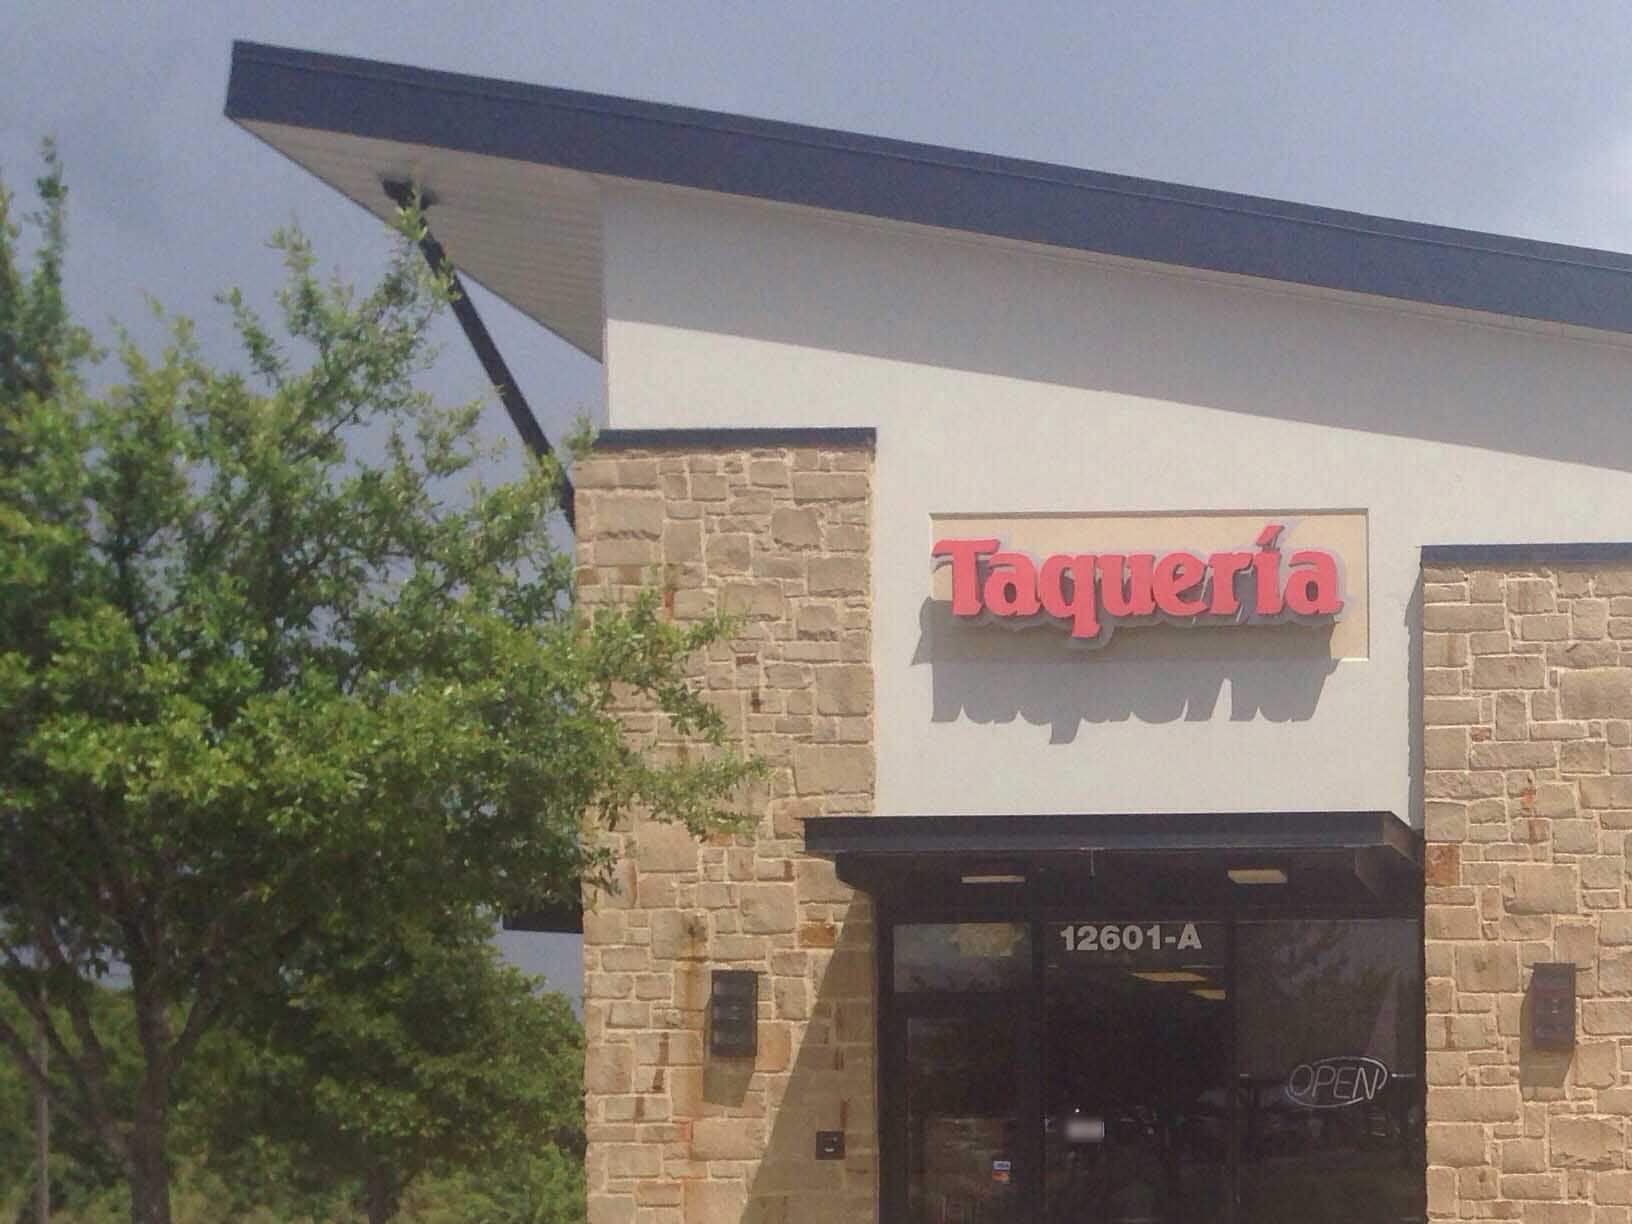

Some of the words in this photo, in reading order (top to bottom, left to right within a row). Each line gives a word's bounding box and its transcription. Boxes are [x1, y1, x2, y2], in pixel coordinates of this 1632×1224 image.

[932, 524, 1343, 638] Taquería
[1060, 923, 1202, 950] 12601-A
[1289, 1064, 1380, 1099] OPEN
